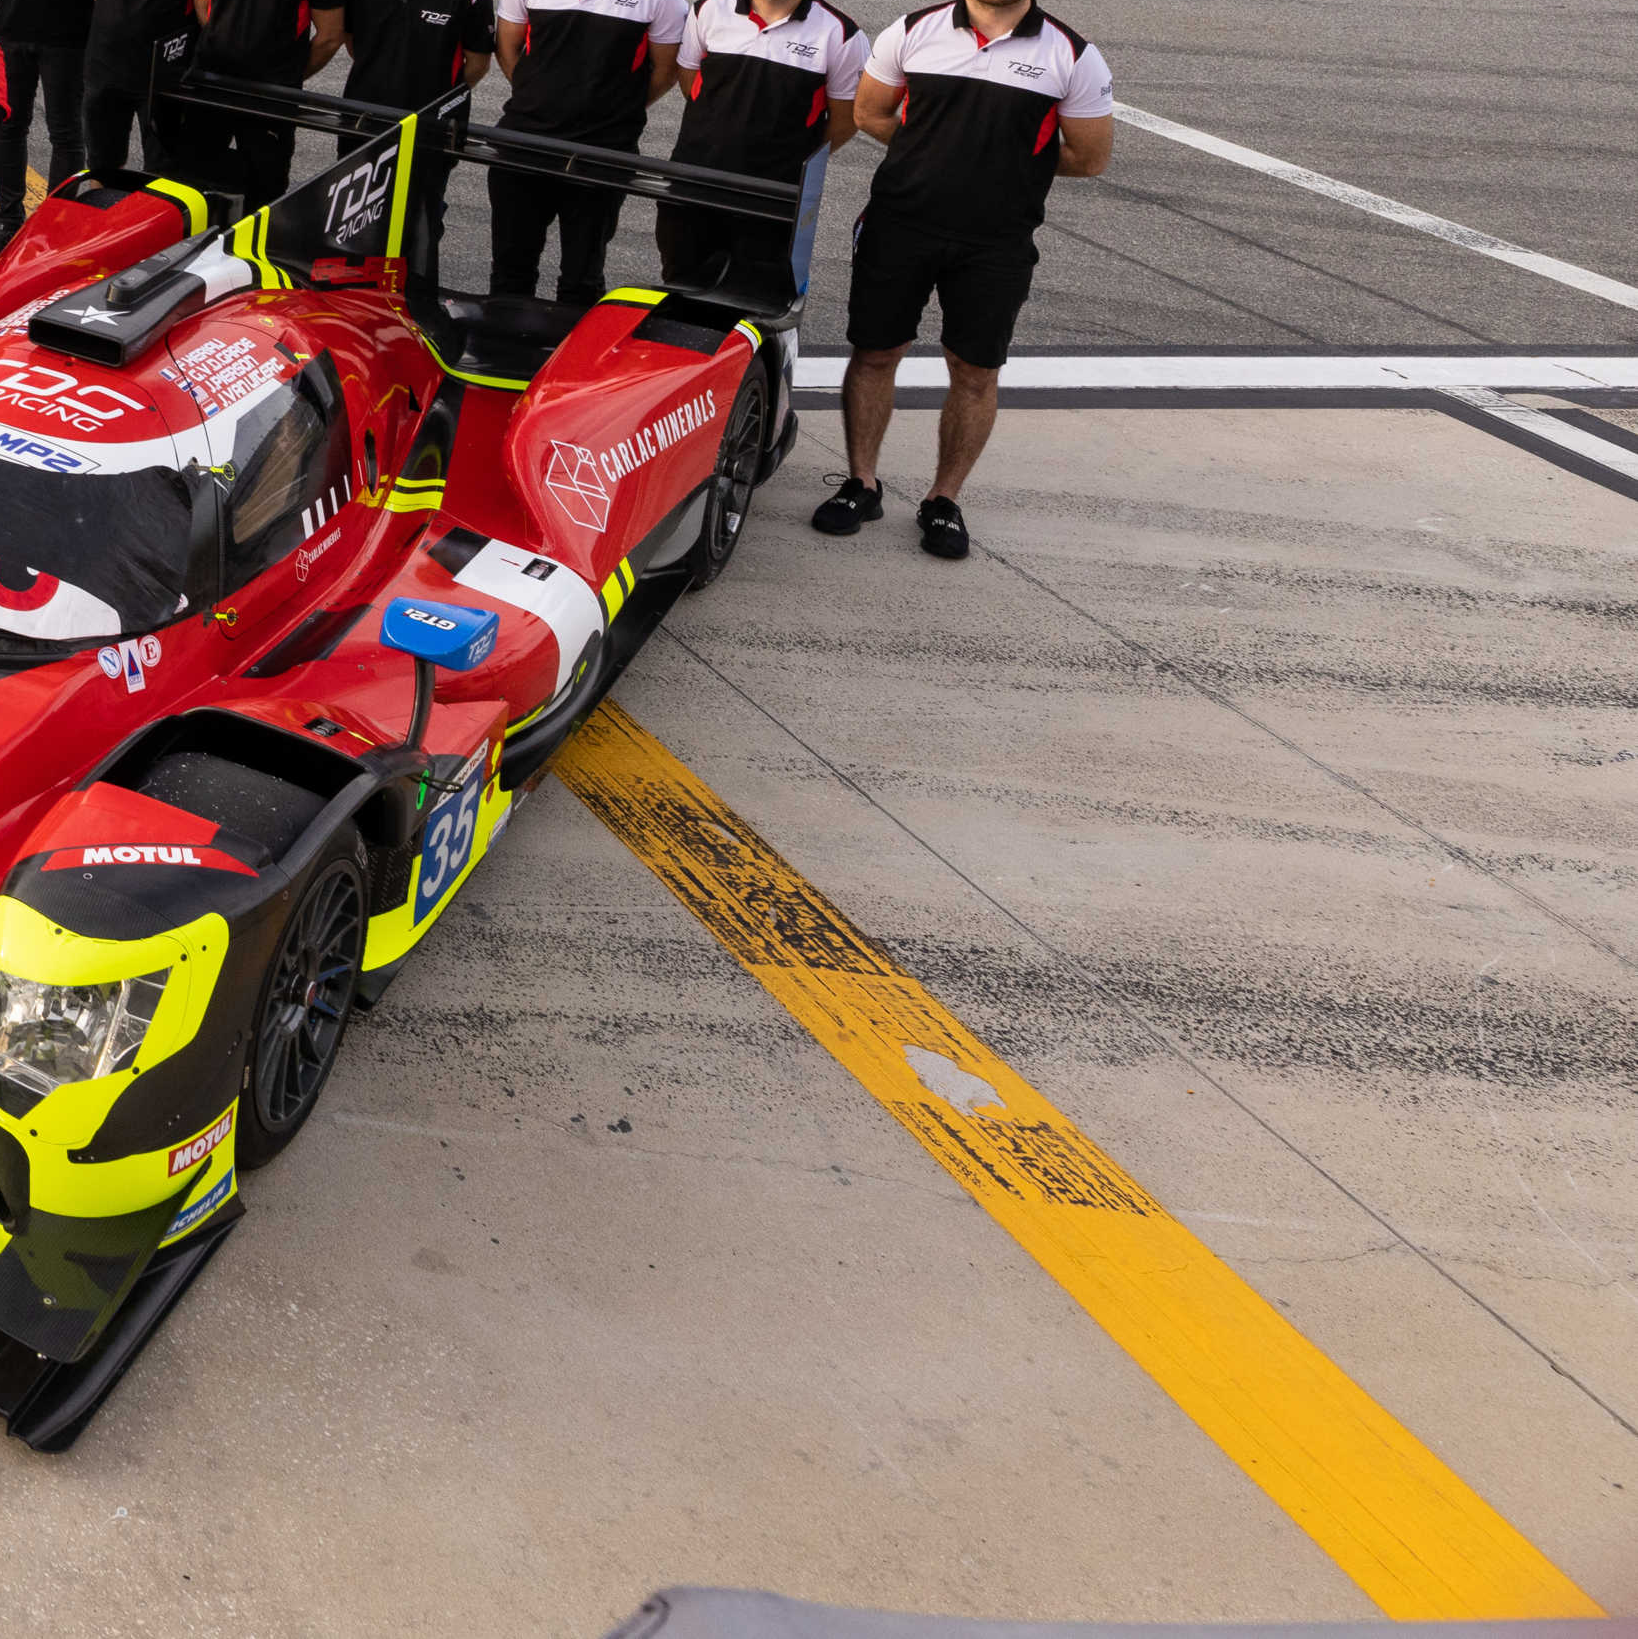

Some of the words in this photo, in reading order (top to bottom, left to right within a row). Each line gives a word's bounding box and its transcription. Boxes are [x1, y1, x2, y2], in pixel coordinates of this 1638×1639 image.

[420, 10, 451, 21] TDS
[785, 41, 819, 53] TDS
[1008, 61, 1046, 75] TDS
[325, 144, 399, 233] TDS
[336, 198, 385, 245] RACING
[600, 425, 655, 483] CARLAC
[653, 389, 717, 450] MINERALS
[145, 640, 158, 662] E
[422, 778, 479, 898] 35
[82, 846, 202, 866] MOTUL
[172, 1114, 232, 1174] MOTUL
